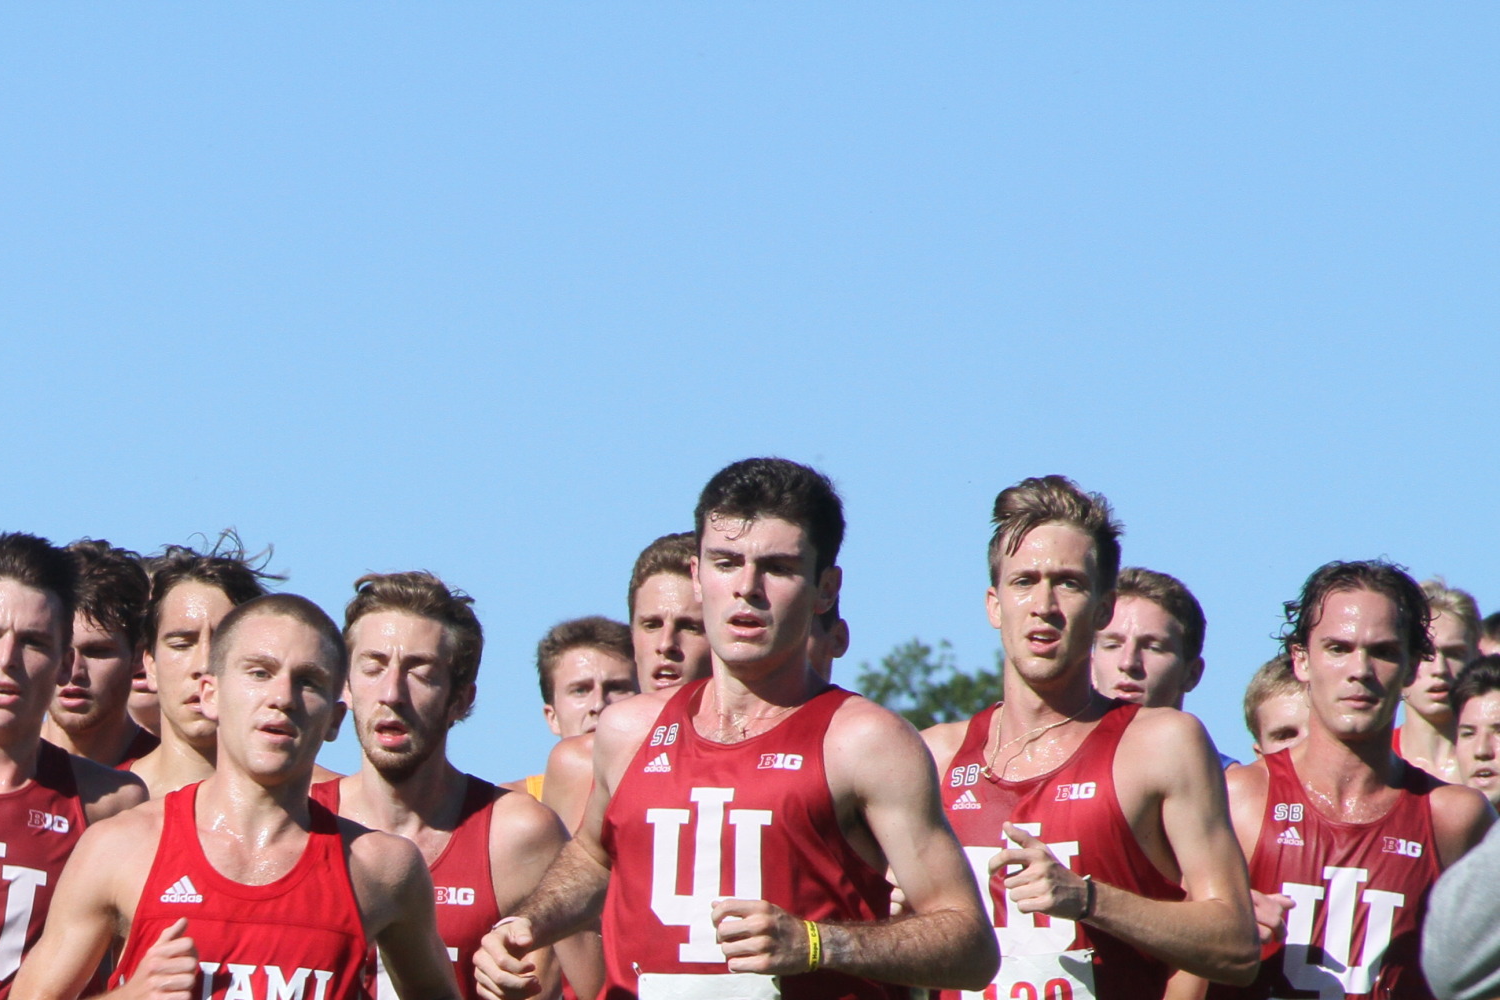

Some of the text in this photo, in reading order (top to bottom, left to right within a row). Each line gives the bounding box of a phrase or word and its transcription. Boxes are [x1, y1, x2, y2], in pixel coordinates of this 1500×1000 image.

[650, 723, 679, 747] SB
[644, 764, 671, 773] adidas
[951, 763, 980, 787] SB
[952, 801, 982, 810] adidas
[1274, 803, 1304, 822] SB
[1277, 836, 1305, 846] adidas
[160, 893, 203, 903] adidas
